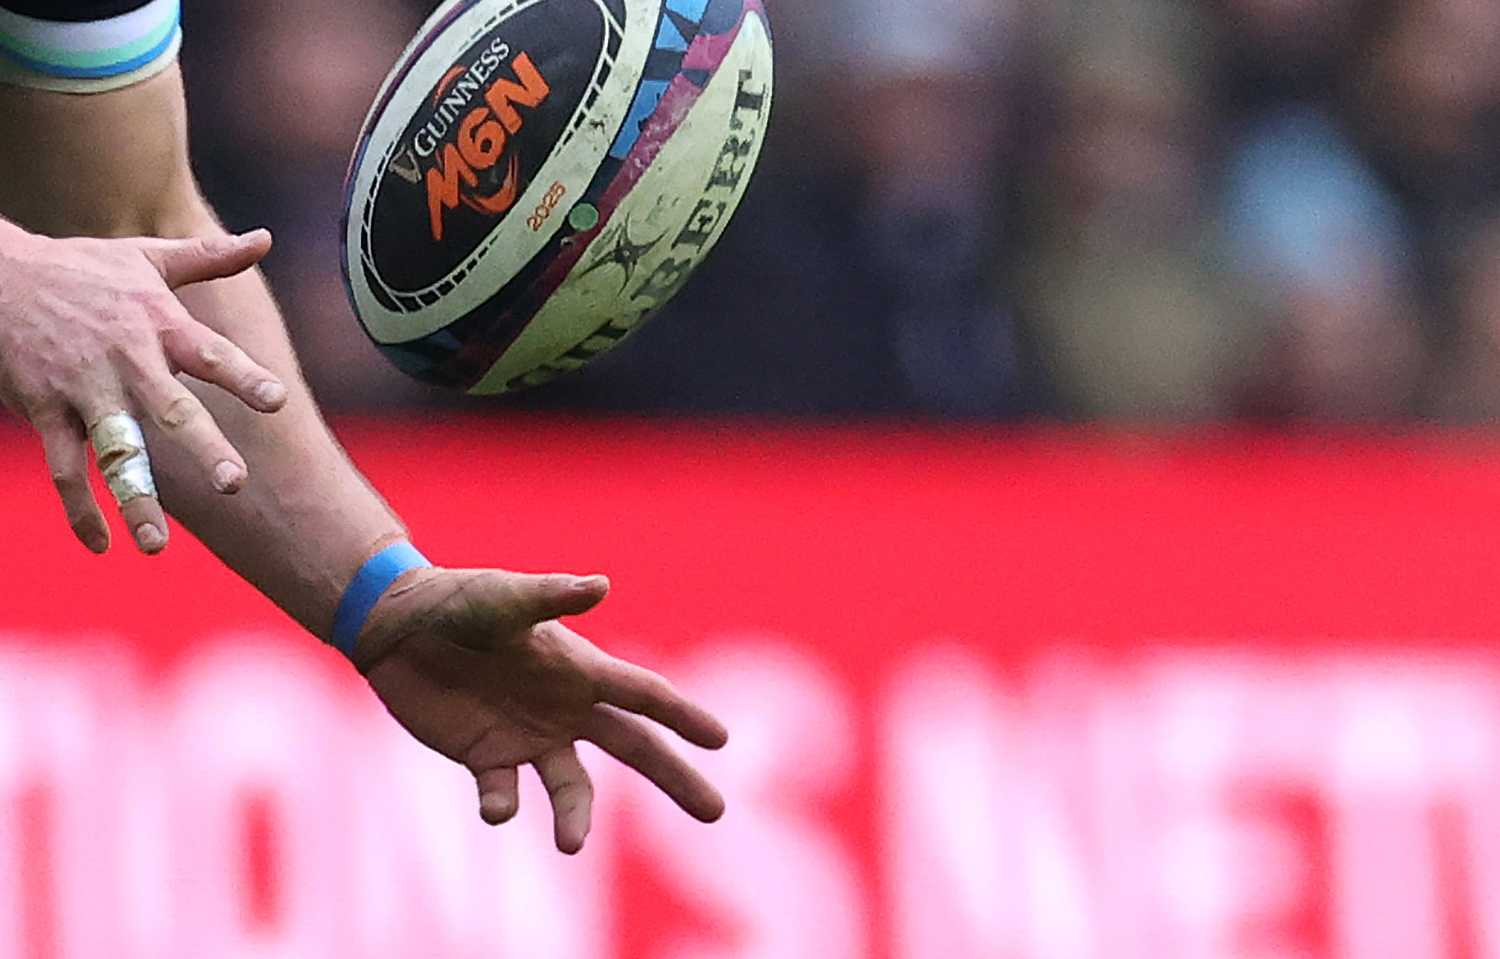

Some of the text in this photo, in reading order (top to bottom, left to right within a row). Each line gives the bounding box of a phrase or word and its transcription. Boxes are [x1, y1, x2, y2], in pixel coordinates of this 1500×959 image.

[414, 37, 510, 157] GUINNESS
[426, 51, 551, 241] M6N
[527, 181, 566, 232] 2025
